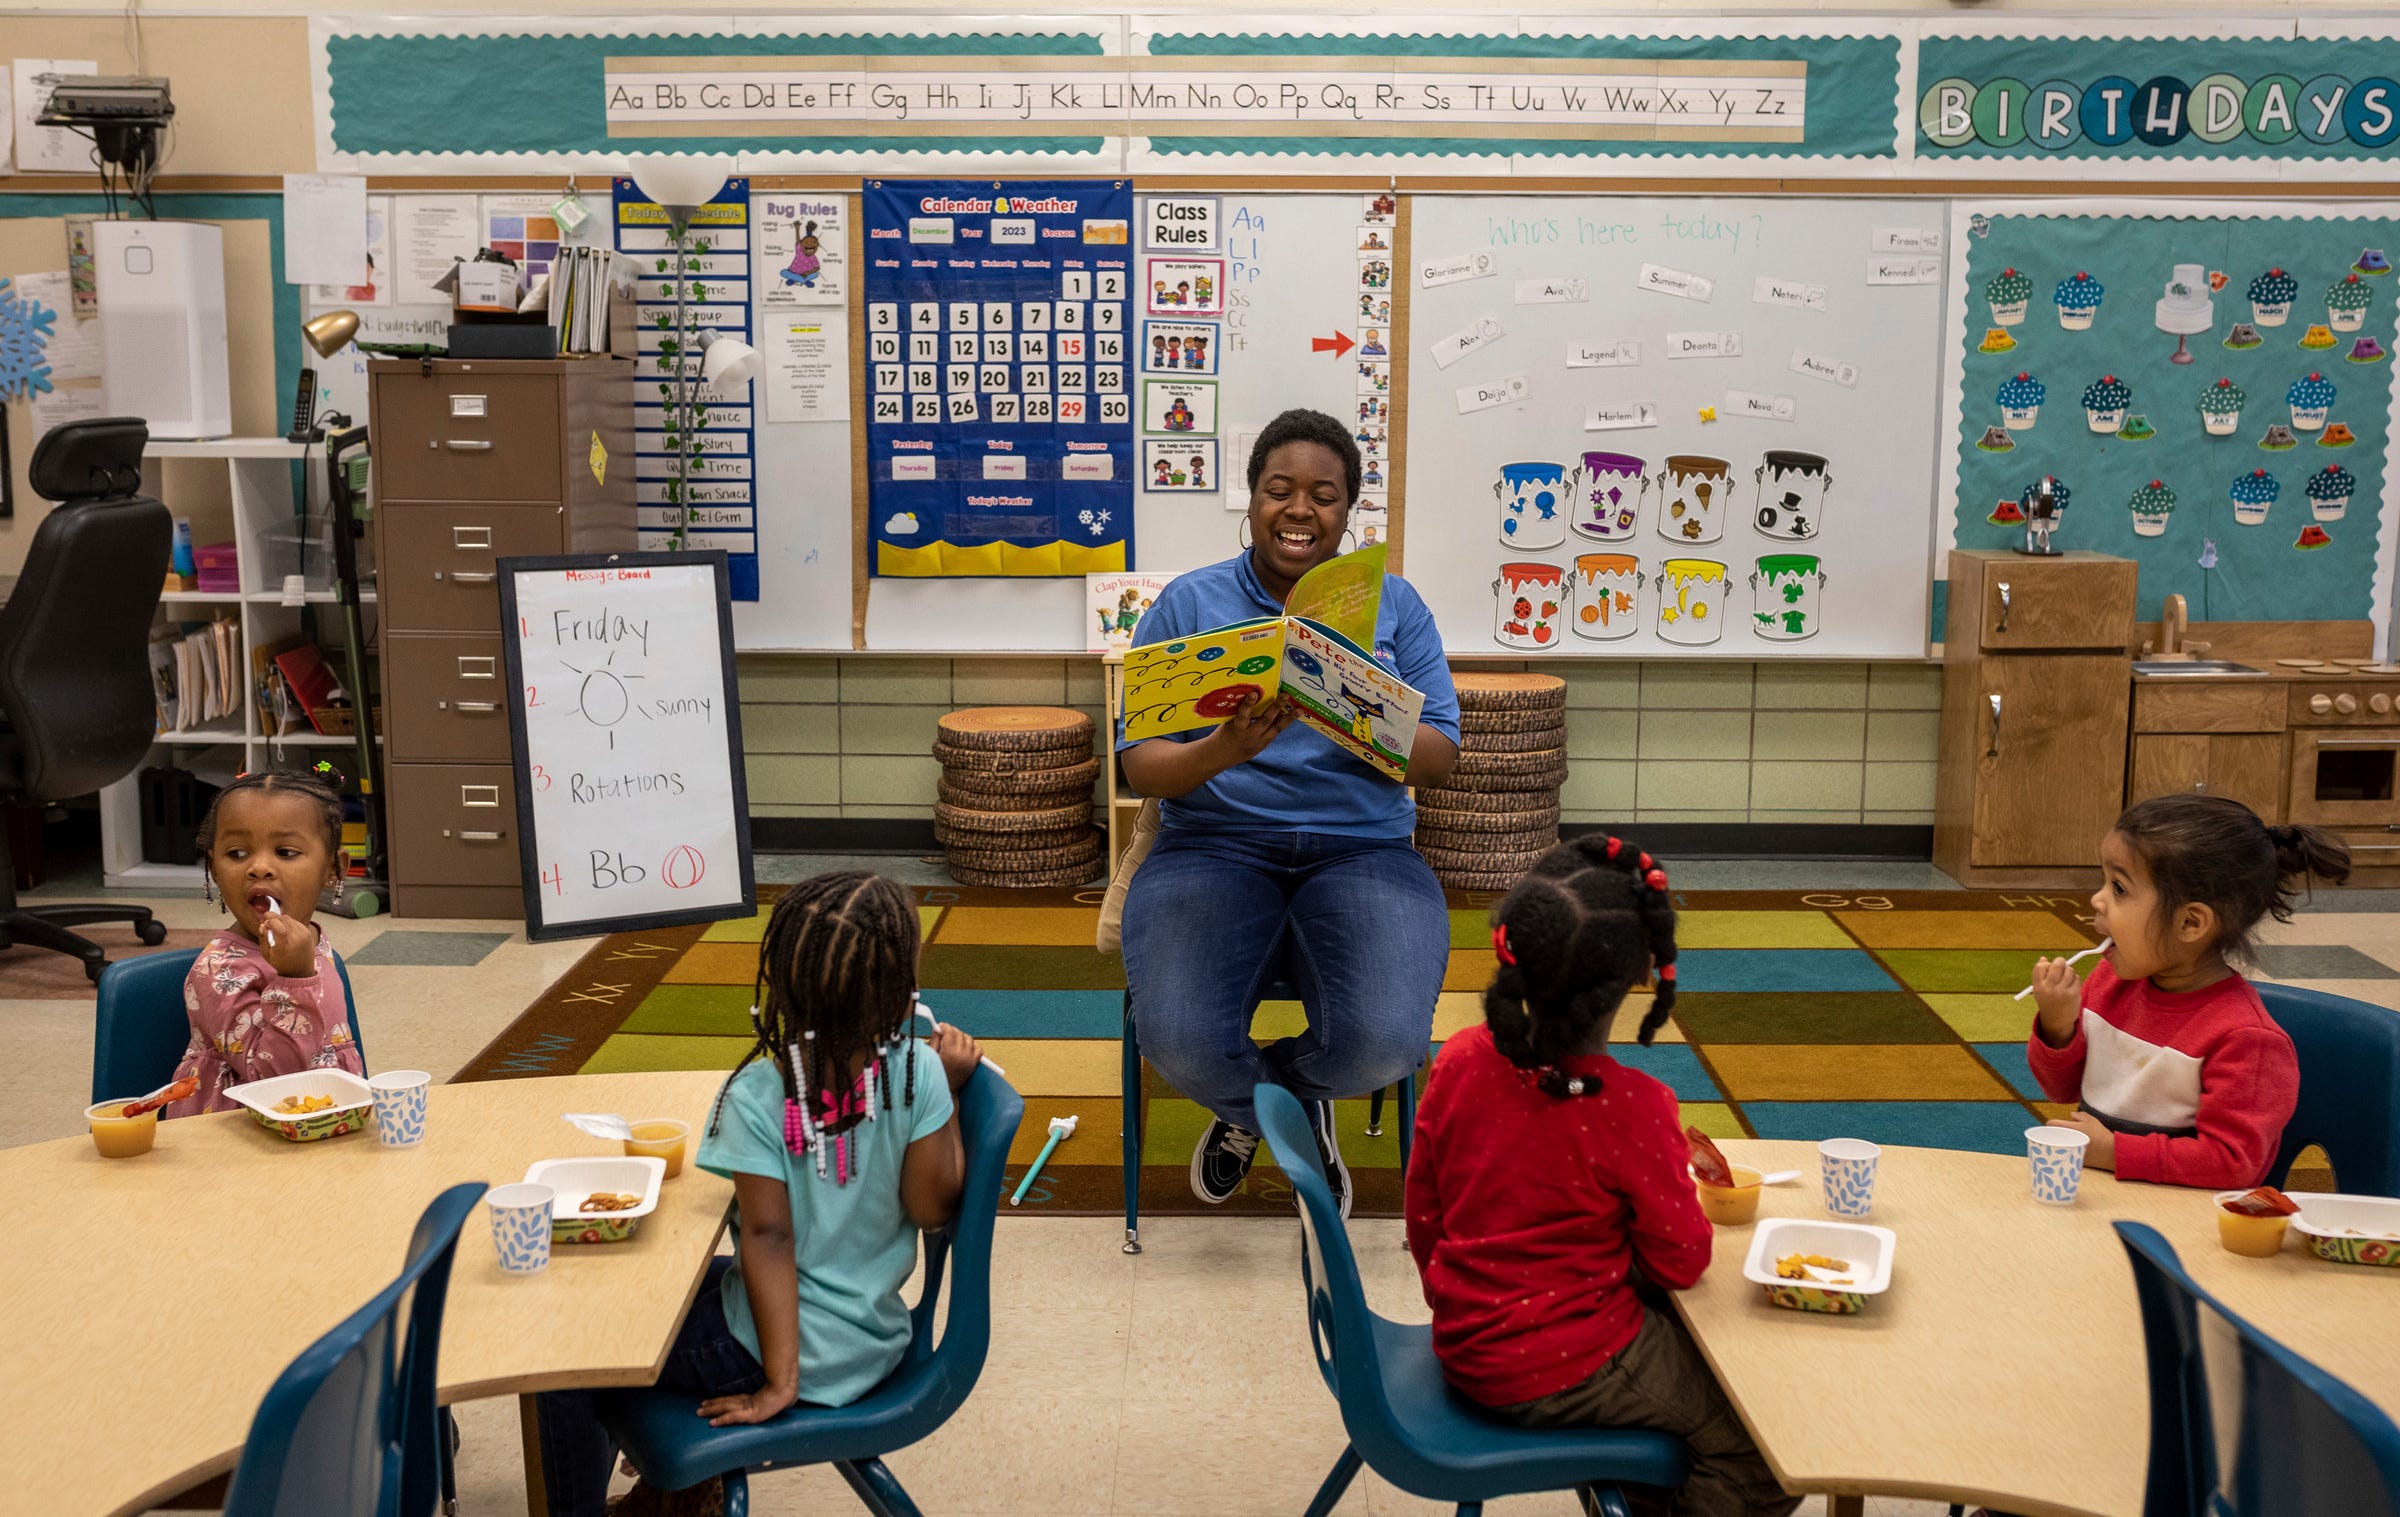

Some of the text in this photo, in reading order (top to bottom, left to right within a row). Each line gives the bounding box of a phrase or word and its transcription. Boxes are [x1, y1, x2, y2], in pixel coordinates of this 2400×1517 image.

[609, 83, 1785, 125] Aa Bb Cc Dd Ee Ff Gg Hh Ii Jj Kk Ll Mm Nn Oo Pp Qq Rr Ss Tt Uu Vv Ww Xx Yy Zz
[1940, 82, 2394, 139] BIRTHDAYS
[767, 202, 838, 219] Rug Rules
[921, 197, 1077, 213] Calendar & Weather
[1157, 202, 1207, 220] Class
[625, 207, 667, 219] Today
[1232, 207, 1264, 232] Aa
[871, 226, 1076, 239] Month December Year 2023 Season
[1156, 225, 1207, 243] Rules
[1488, 217, 1560, 245] Who's
[1577, 216, 1638, 244] here
[875, 259, 900, 269] Sunday
[912, 259, 938, 269] Monday
[949, 259, 976, 269] Tuesday
[1022, 259, 1051, 269] Thursday
[1424, 264, 1471, 279] Glorianne
[1073, 279, 1116, 294] 1 2
[1650, 272, 1688, 290] Summer
[1544, 286, 1564, 296] Ava
[643, 308, 679, 321] Smal
[878, 309, 1113, 325] 3 4 5 6 7 8 9
[876, 340, 1118, 355] 10 11 12 13 14 15 16
[1459, 334, 1480, 349] Alex
[1682, 340, 1717, 351] Deonta
[1582, 349, 1616, 363] Legend
[1802, 358, 1836, 376] Aubree
[880, 371, 1119, 387] 17 18 19 20 21 22 23
[877, 400, 1126, 417] 24 25 26 27 28 29 30
[1748, 400, 1772, 411] Nova
[707, 411, 741, 423] hoice
[1598, 411, 1633, 422] Harlem
[2012, 411, 2028, 419] MAY
[892, 440, 1107, 451] Yesterday Today Tomorrow
[708, 461, 742, 474] Time
[899, 463, 1099, 473] Thursday Friday Saturday
[715, 488, 749, 500] Snack
[967, 496, 1033, 507] Today's Weather
[618, 569, 651, 581] Board
[1095, 578, 1164, 594] Clap Your Han
[554, 606, 649, 656] Friday
[1299, 626, 1346, 664] Pete
[1366, 669, 1406, 700] Cat
[570, 771, 685, 805] Rotations
[590, 849, 646, 890] Bb
[1801, 893, 1894, 910] Gg
